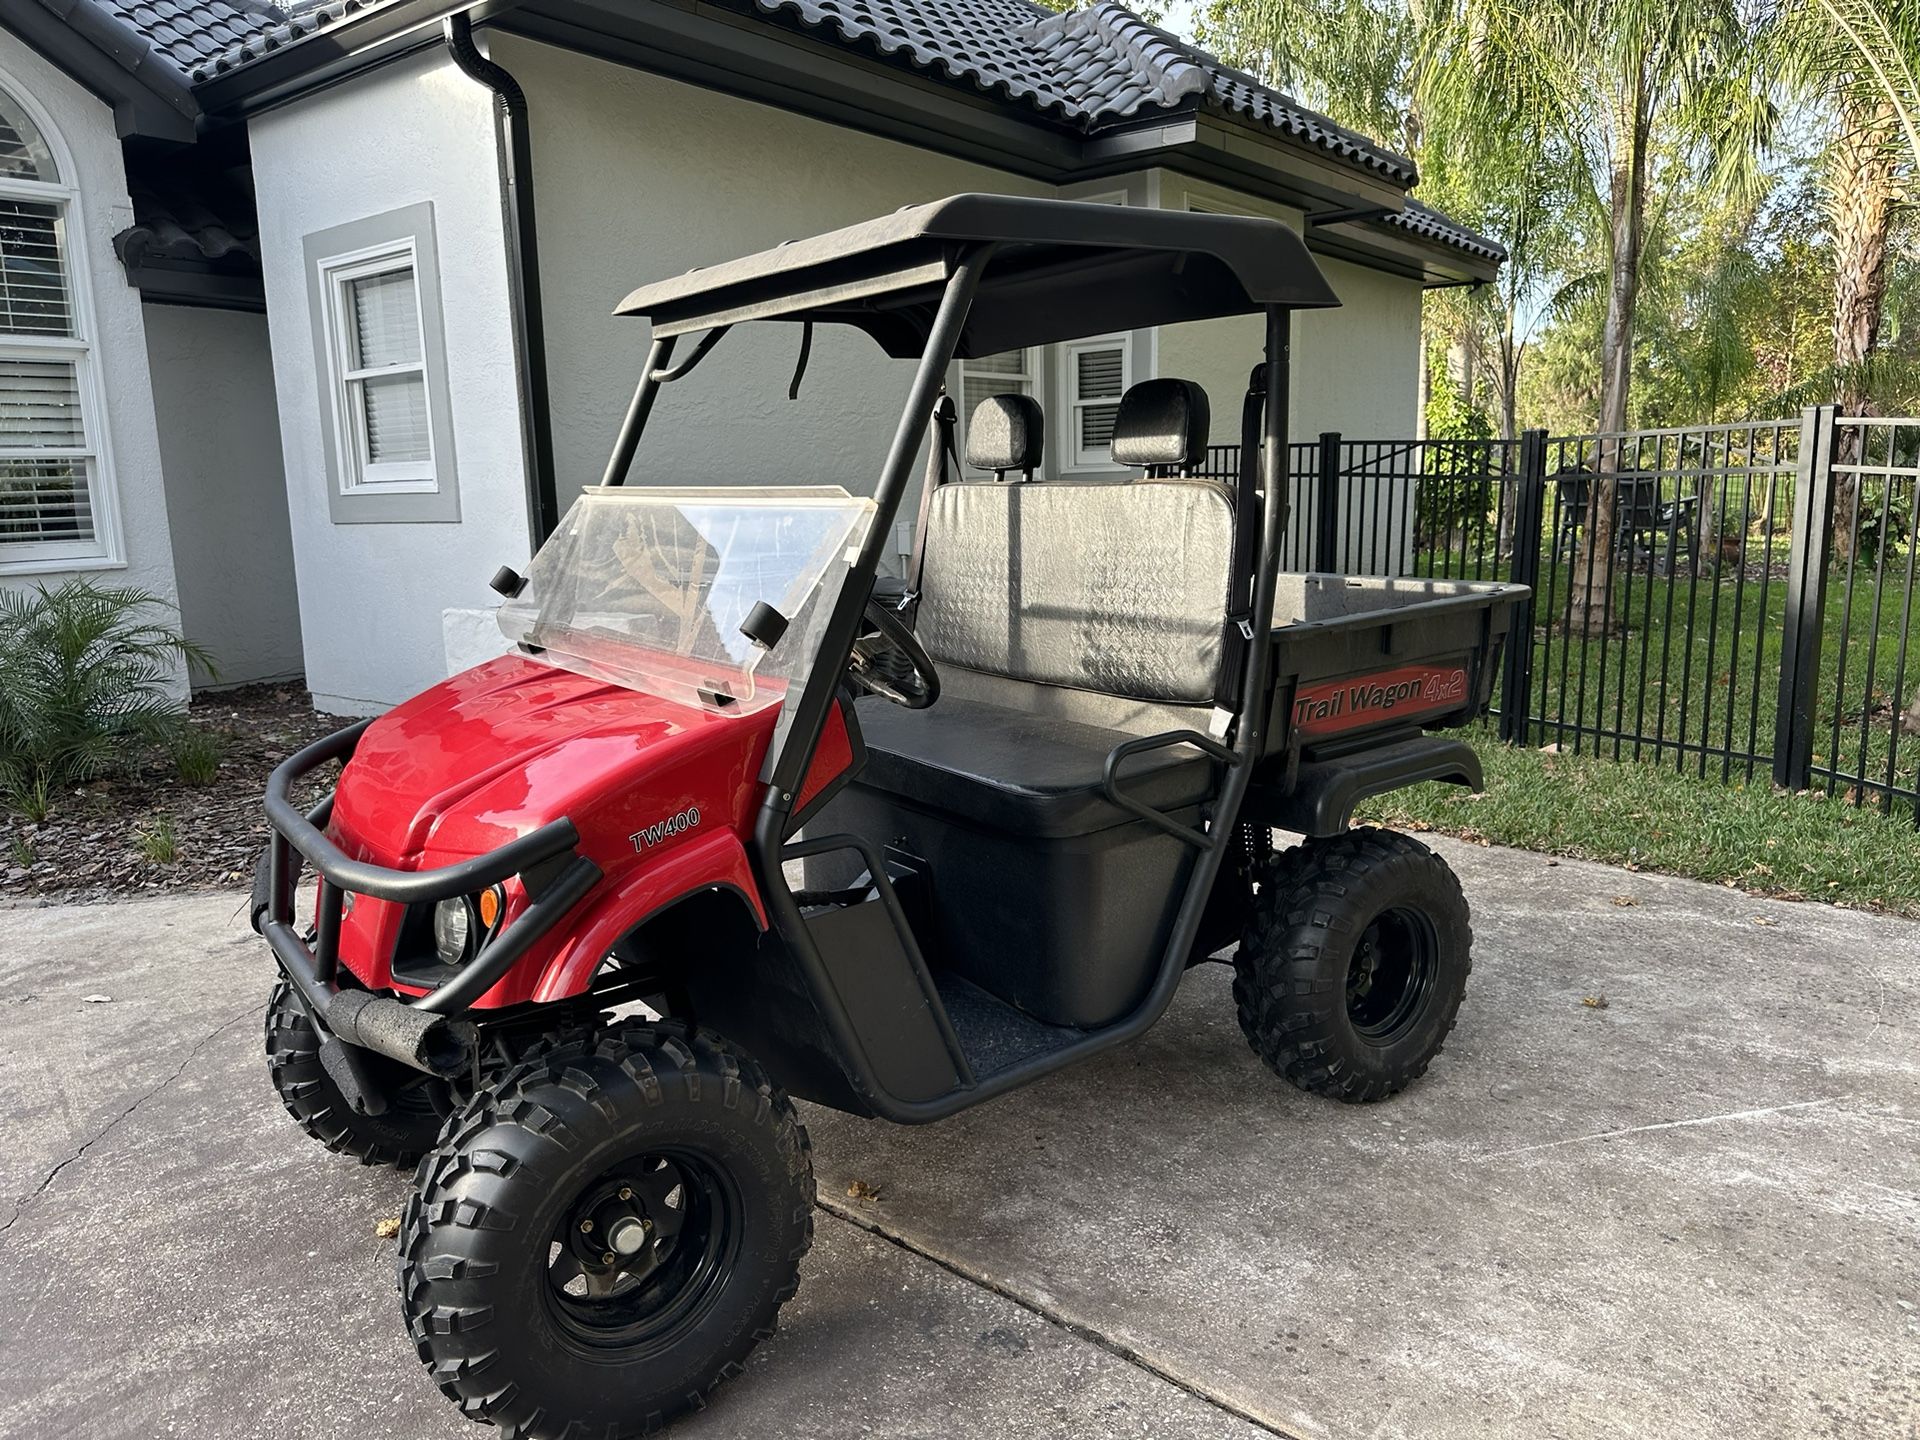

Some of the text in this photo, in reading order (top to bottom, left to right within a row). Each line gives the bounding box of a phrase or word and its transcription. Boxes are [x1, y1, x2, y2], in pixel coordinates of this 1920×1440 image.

[1294, 669, 1465, 724] Trail Wagon 4x2
[629, 807, 700, 853] TW400
